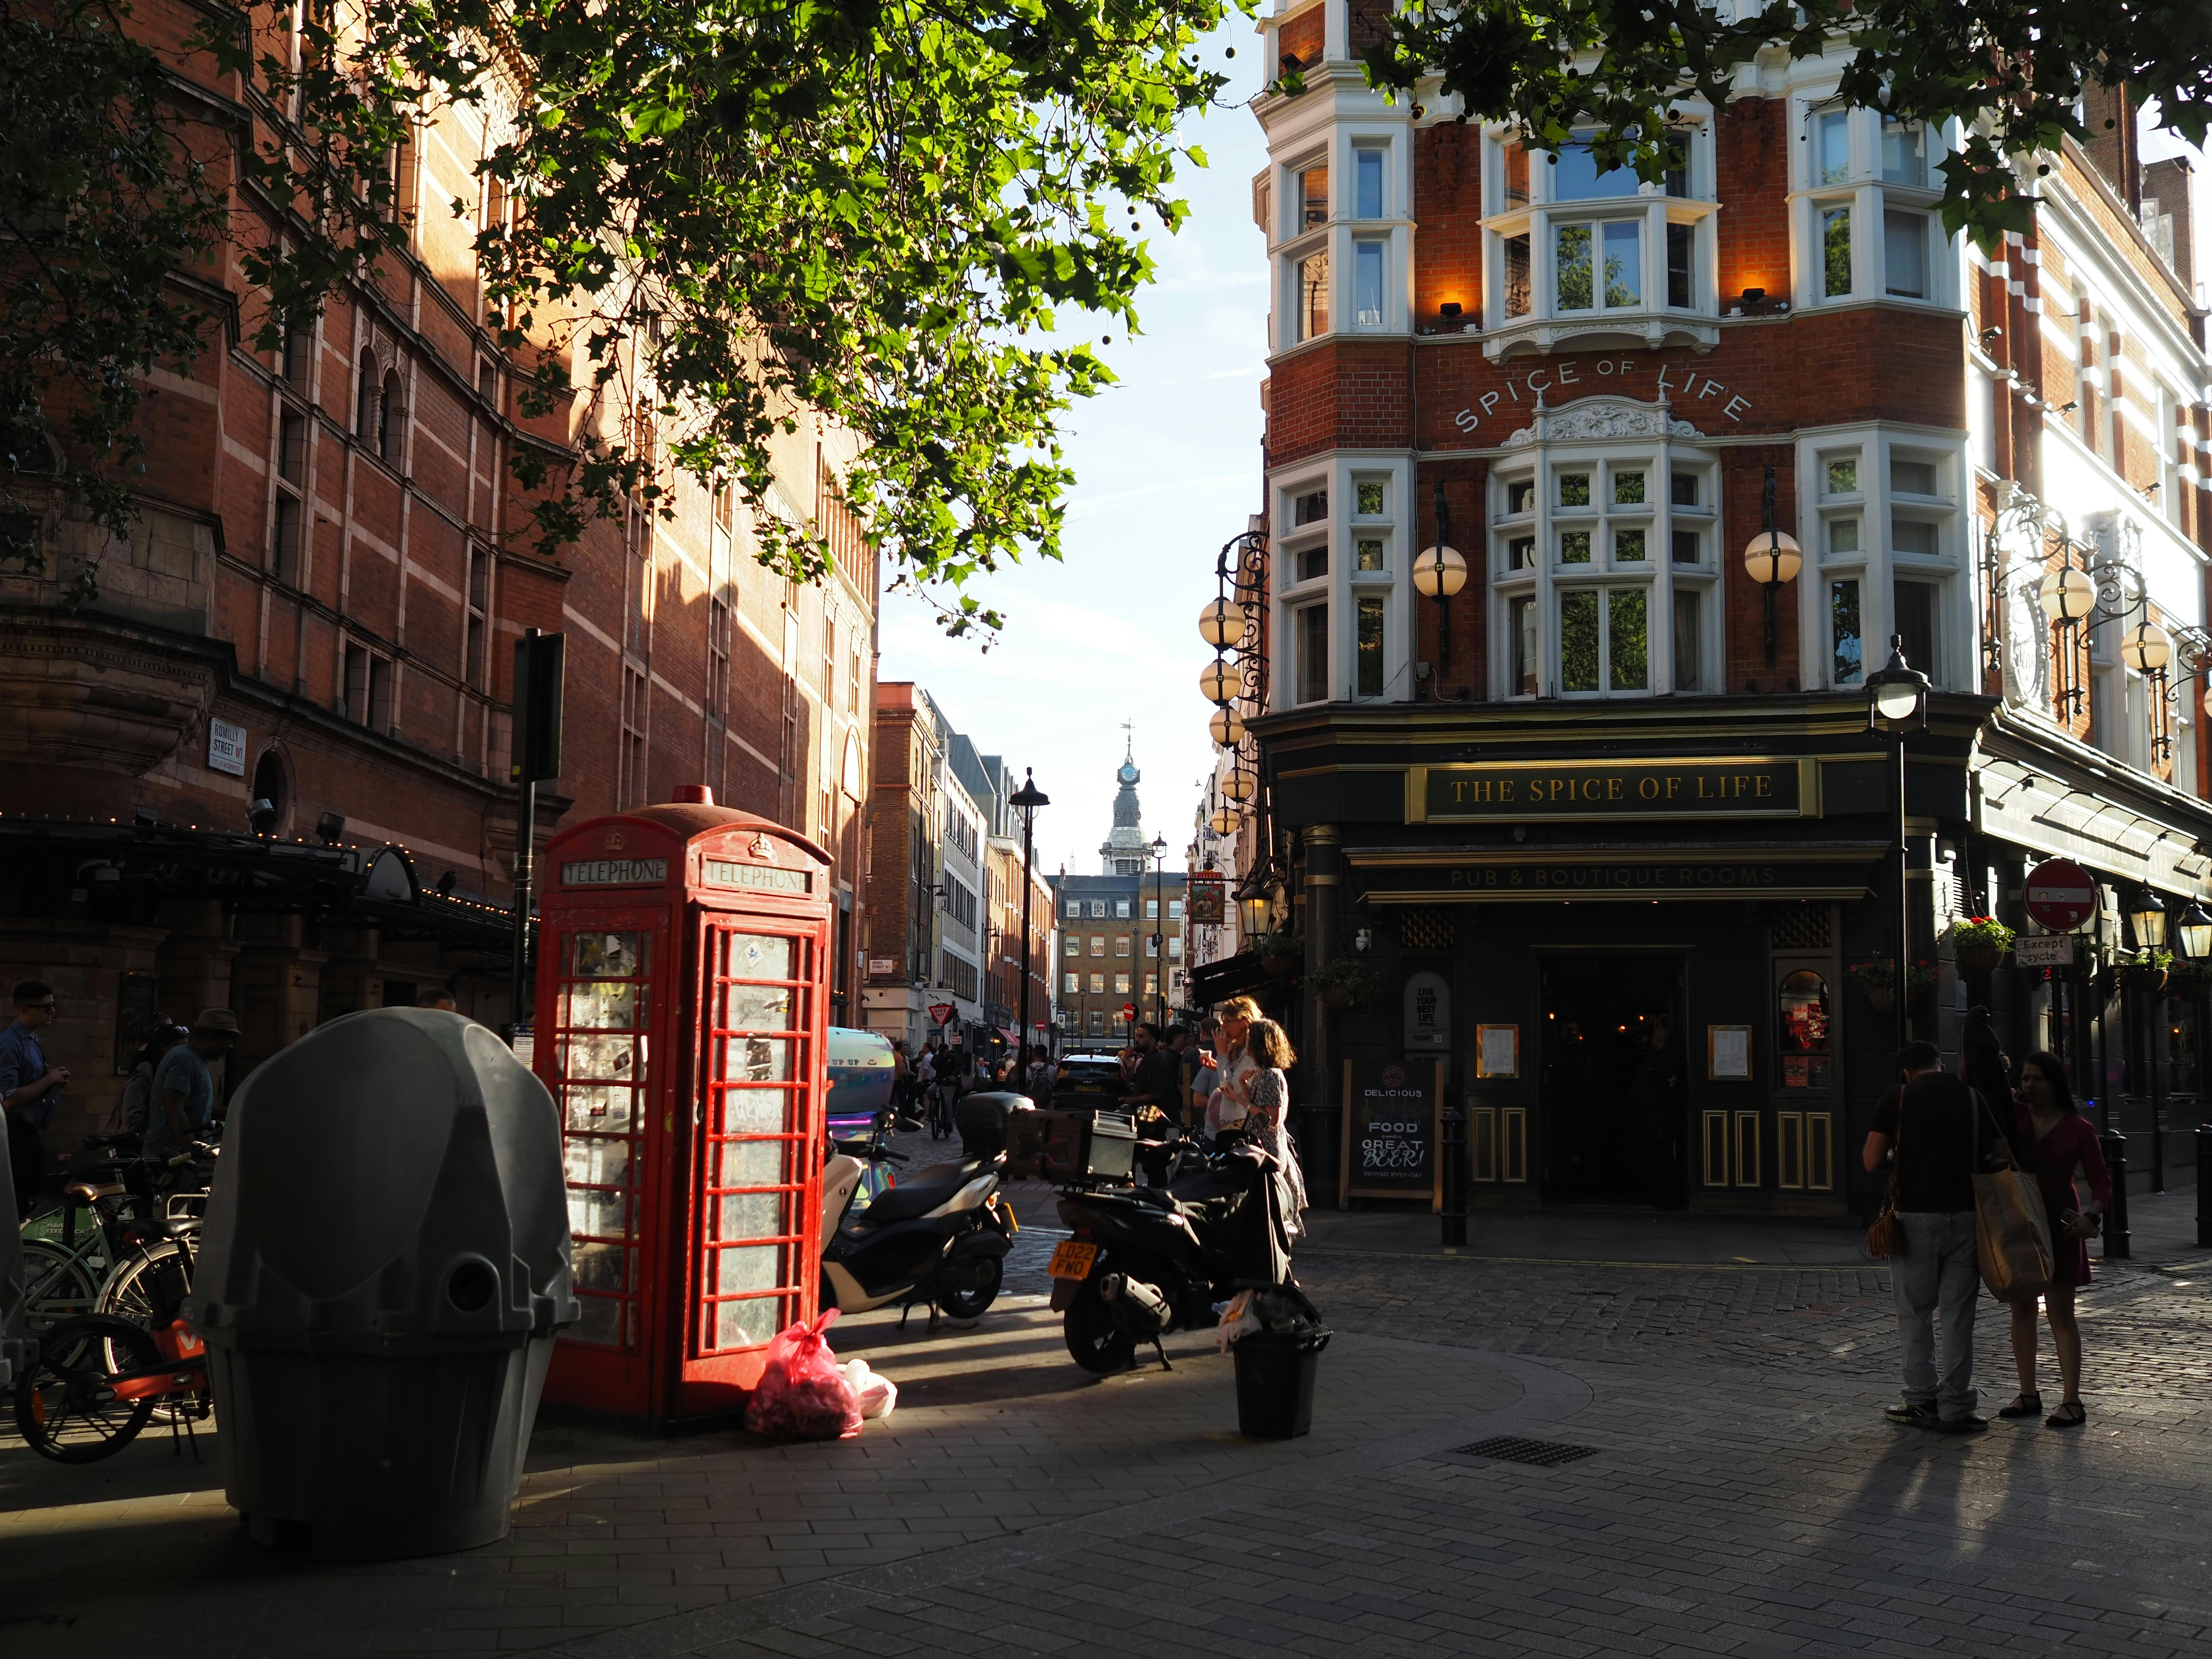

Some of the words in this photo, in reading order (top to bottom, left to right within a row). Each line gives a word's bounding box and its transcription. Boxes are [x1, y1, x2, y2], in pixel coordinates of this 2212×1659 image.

[1455, 361, 1580, 434] SPICE
[1597, 360, 1635, 375] OF
[1657, 363, 1752, 422] LIFE
[214, 723, 239, 742] ROMILLY
[213, 739, 234, 756] STREET
[236, 745, 243, 759] W1
[1451, 780, 1515, 802] THE
[1530, 778, 1624, 801] SPICE
[1638, 777, 1682, 799] OF
[1697, 774, 1773, 799] LIFE
[2065, 815, 2090, 852] THE
[2094, 825, 2128, 864] SPICE
[2148, 847, 2171, 879] LIFE
[568, 861, 664, 882] TELEPHONE
[709, 862, 806, 891] TELEPHONE
[1451, 869, 1498, 885] PUB
[1510, 869, 1523, 885] &
[1536, 868, 1666, 888] BOUTIQUE
[1679, 867, 1775, 885] ROOMS
[2024, 938, 2064, 949] Except
[1416, 996, 1437, 1004] YOUR
[1418, 988, 1435, 996] LIVE
[1417, 1005, 1436, 1013] BEST
[1419, 1013, 1435, 1022] LIFE
[1364, 1089, 1423, 1097] DELICIOUS
[1368, 1122, 1418, 1133] FOOD
[1362, 1139, 1423, 1150] GREAT
[1362, 1148, 1424, 1167] BEER!
[1057, 1243, 1094, 1260] LD22
